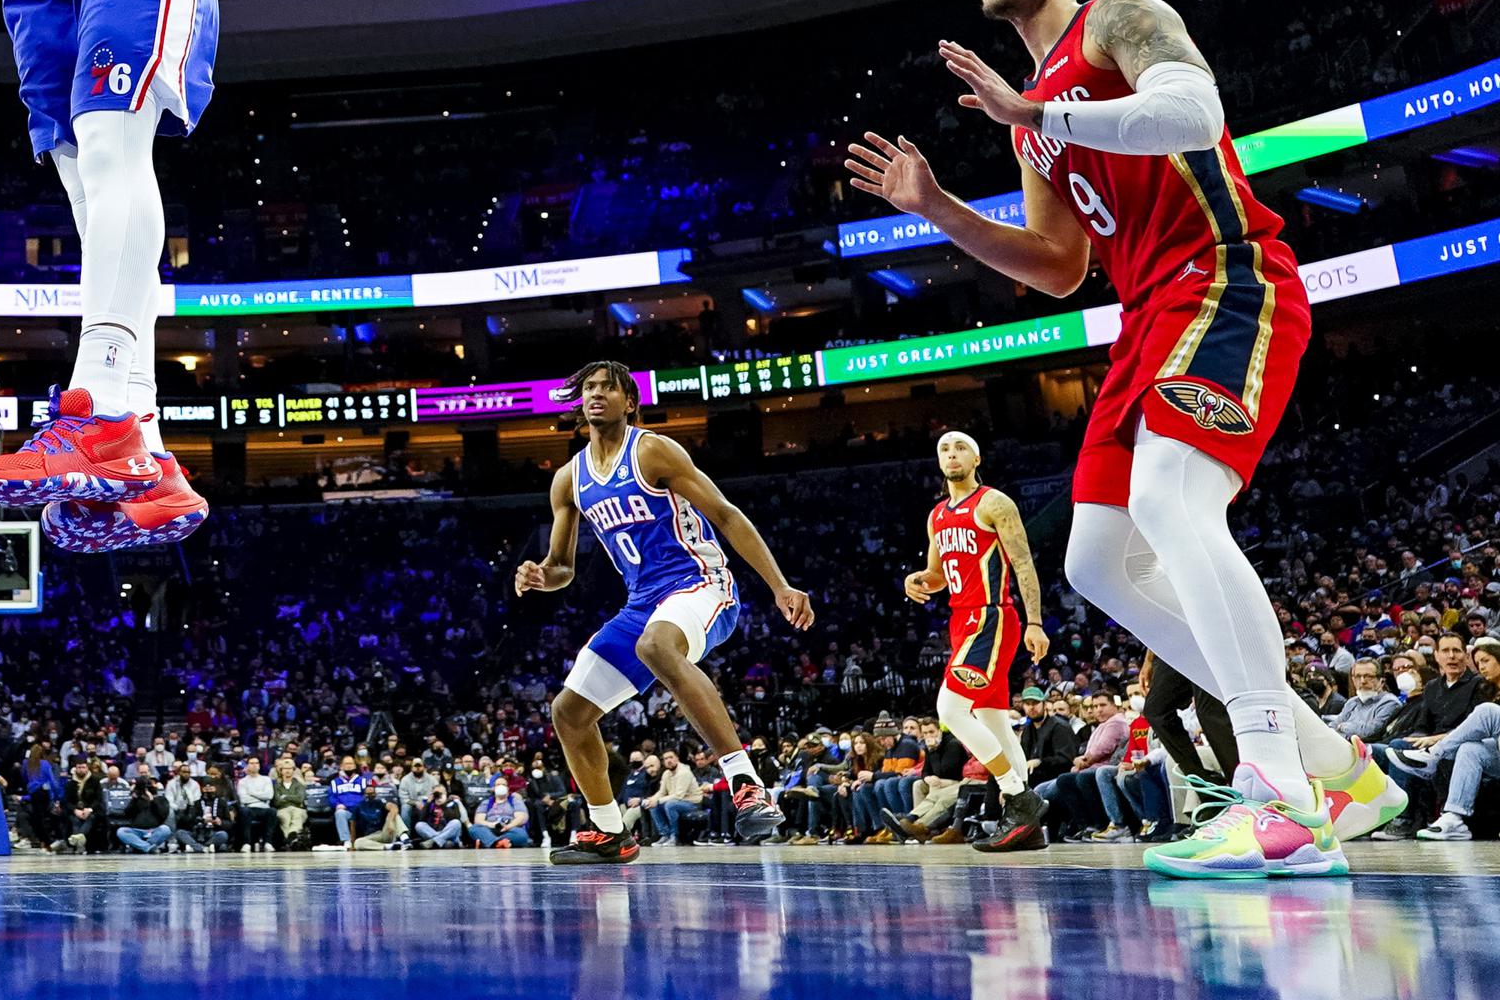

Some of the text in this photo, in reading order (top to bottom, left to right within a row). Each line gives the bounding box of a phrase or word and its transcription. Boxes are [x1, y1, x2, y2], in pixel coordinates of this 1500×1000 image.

[90, 62, 133, 97] 76
[1403, 89, 1462, 119] AUTO.
[1068, 171, 1118, 238] 9
[1439, 235, 1489, 262] JUST
[493, 267, 540, 295] NJM
[13, 288, 60, 311] NJM
[199, 286, 389, 307] AUTO. HOME. RENTERS.
[846, 326, 1063, 372] JUST GREAT INSURANCE
[710, 373, 731, 386] PHI
[712, 385, 732, 399] NO
[163, 406, 215, 421] PELICANS
[235, 409, 272, 426] 5 5
[285, 398, 323, 410] PLAYER
[286, 410, 323, 423] POINTS
[585, 494, 656, 535] PHILA
[616, 531, 642, 565] 0
[942, 558, 963, 595] 15
